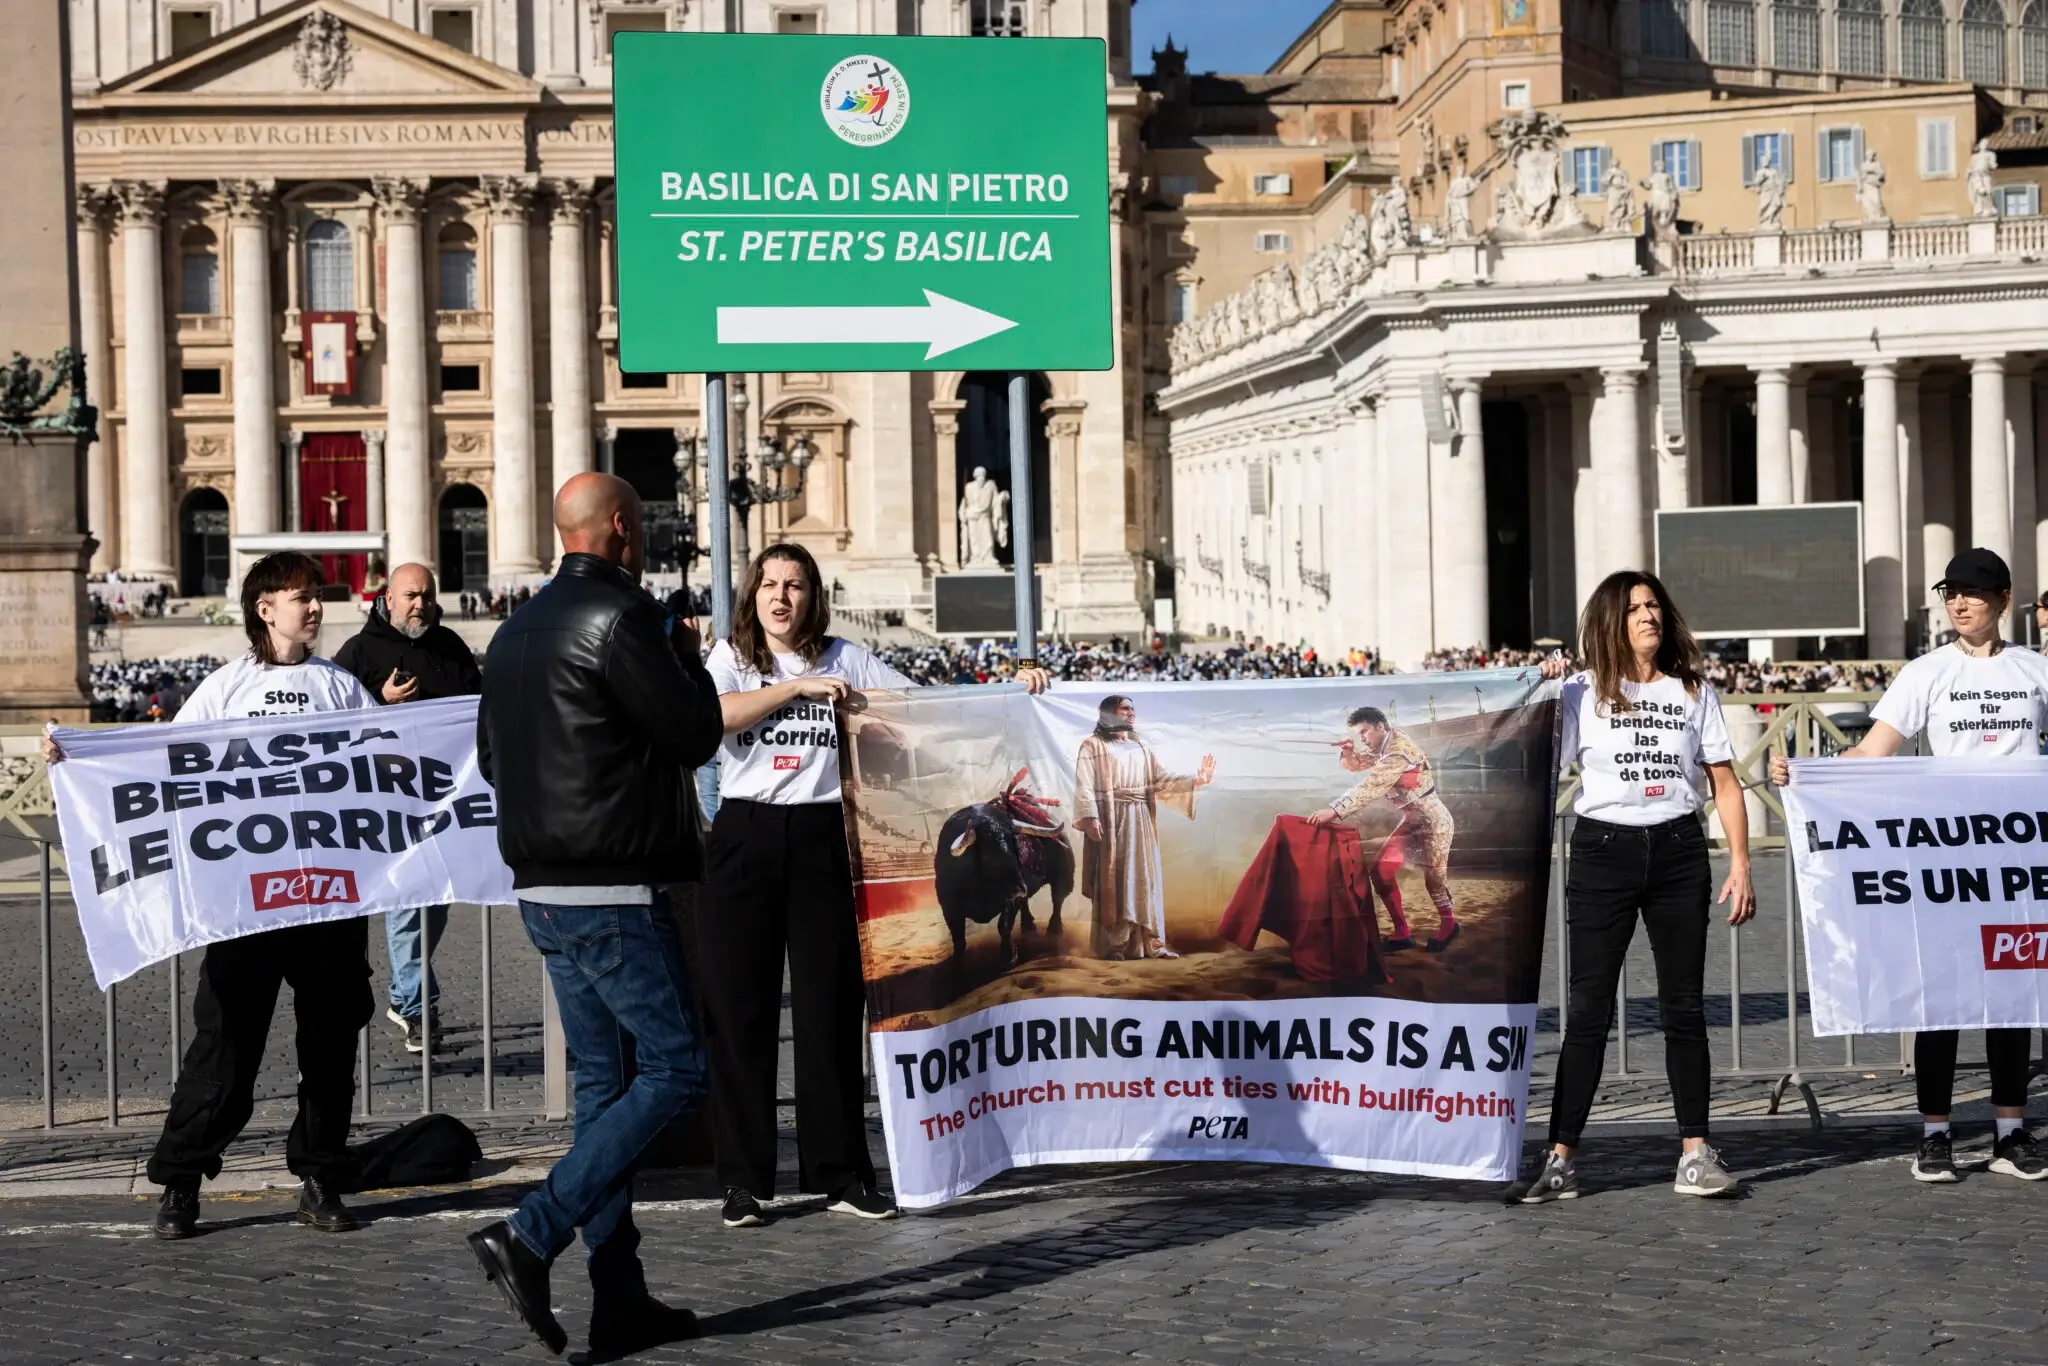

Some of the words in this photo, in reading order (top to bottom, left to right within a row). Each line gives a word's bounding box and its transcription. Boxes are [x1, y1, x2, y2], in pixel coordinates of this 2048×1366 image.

[75, 129, 119, 147] OST
[397, 124, 524, 143] ROMANVS
[838, 113, 904, 142] PEREGRINANTES
[661, 172, 819, 201] BASILICA
[830, 172, 861, 201] DI
[870, 172, 938, 201] SAN
[949, 172, 1069, 202] PIETRO
[677, 231, 727, 261] ST.
[739, 230, 886, 261] PETER'S
[895, 230, 1053, 262] BASILICA
[264, 690, 310, 706] Stop
[1949, 690, 1981, 702] Kein
[1984, 690, 2028, 701] Segen
[768, 704, 834, 723] nedir
[1610, 700, 1659, 715] Bsta
[1662, 703, 1684, 716] de
[1980, 703, 2001, 714] für
[1610, 716, 1686, 731] bendecir
[1949, 718, 2033, 733] Stierkämpfe
[760, 727, 837, 750] Corride
[1634, 732, 1659, 746] las
[167, 727, 399, 776] BASTA
[1619, 768, 1640, 781] de
[112, 753, 459, 824] BENEDIRE
[91, 828, 173, 895] LE
[190, 792, 498, 861] CORRIDE
[1805, 820, 1870, 853] LA
[1875, 811, 2048, 848] TAURO
[1852, 869, 1912, 905] ES
[1921, 867, 1991, 904] UN
[2001, 866, 2048, 902] PE
[895, 1016, 1142, 1100] TORTURING
[1155, 1017, 1375, 1063] ANIMALS
[1386, 1021, 1429, 1071] IS
[1439, 1026, 1475, 1072] A
[1485, 1026, 1528, 1072] SIN
[920, 1111, 965, 1141] The
[968, 1080, 1065, 1120] Church
[1075, 1077, 1155, 1099] must
[1164, 1077, 1214, 1097] cut
[1222, 1075, 1277, 1099] ties
[1287, 1077, 1350, 1106] with
[1359, 1084, 1516, 1124] bullfightin
